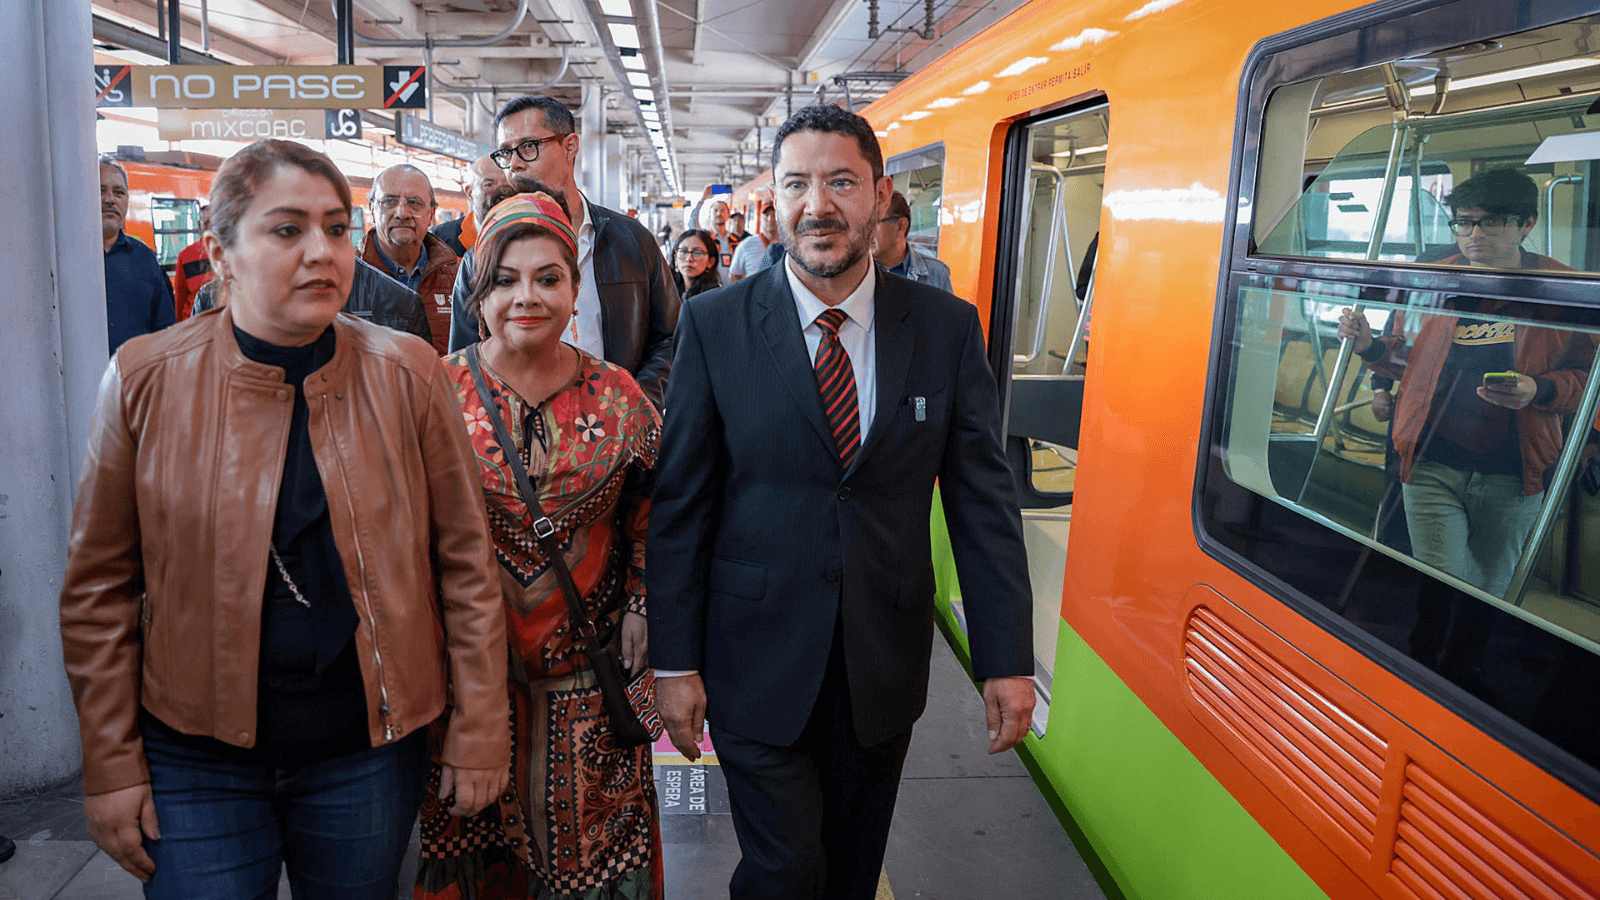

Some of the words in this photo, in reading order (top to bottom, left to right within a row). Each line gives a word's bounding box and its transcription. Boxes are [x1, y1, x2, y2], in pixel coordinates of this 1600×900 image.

[149, 74, 216, 99] NO
[233, 74, 365, 99] PASE
[191, 120, 306, 137] MIXCOAC
[664, 770, 682, 808] ESPERA
[689, 767, 709, 795] ÁREA
[689, 796, 705, 811] DE
